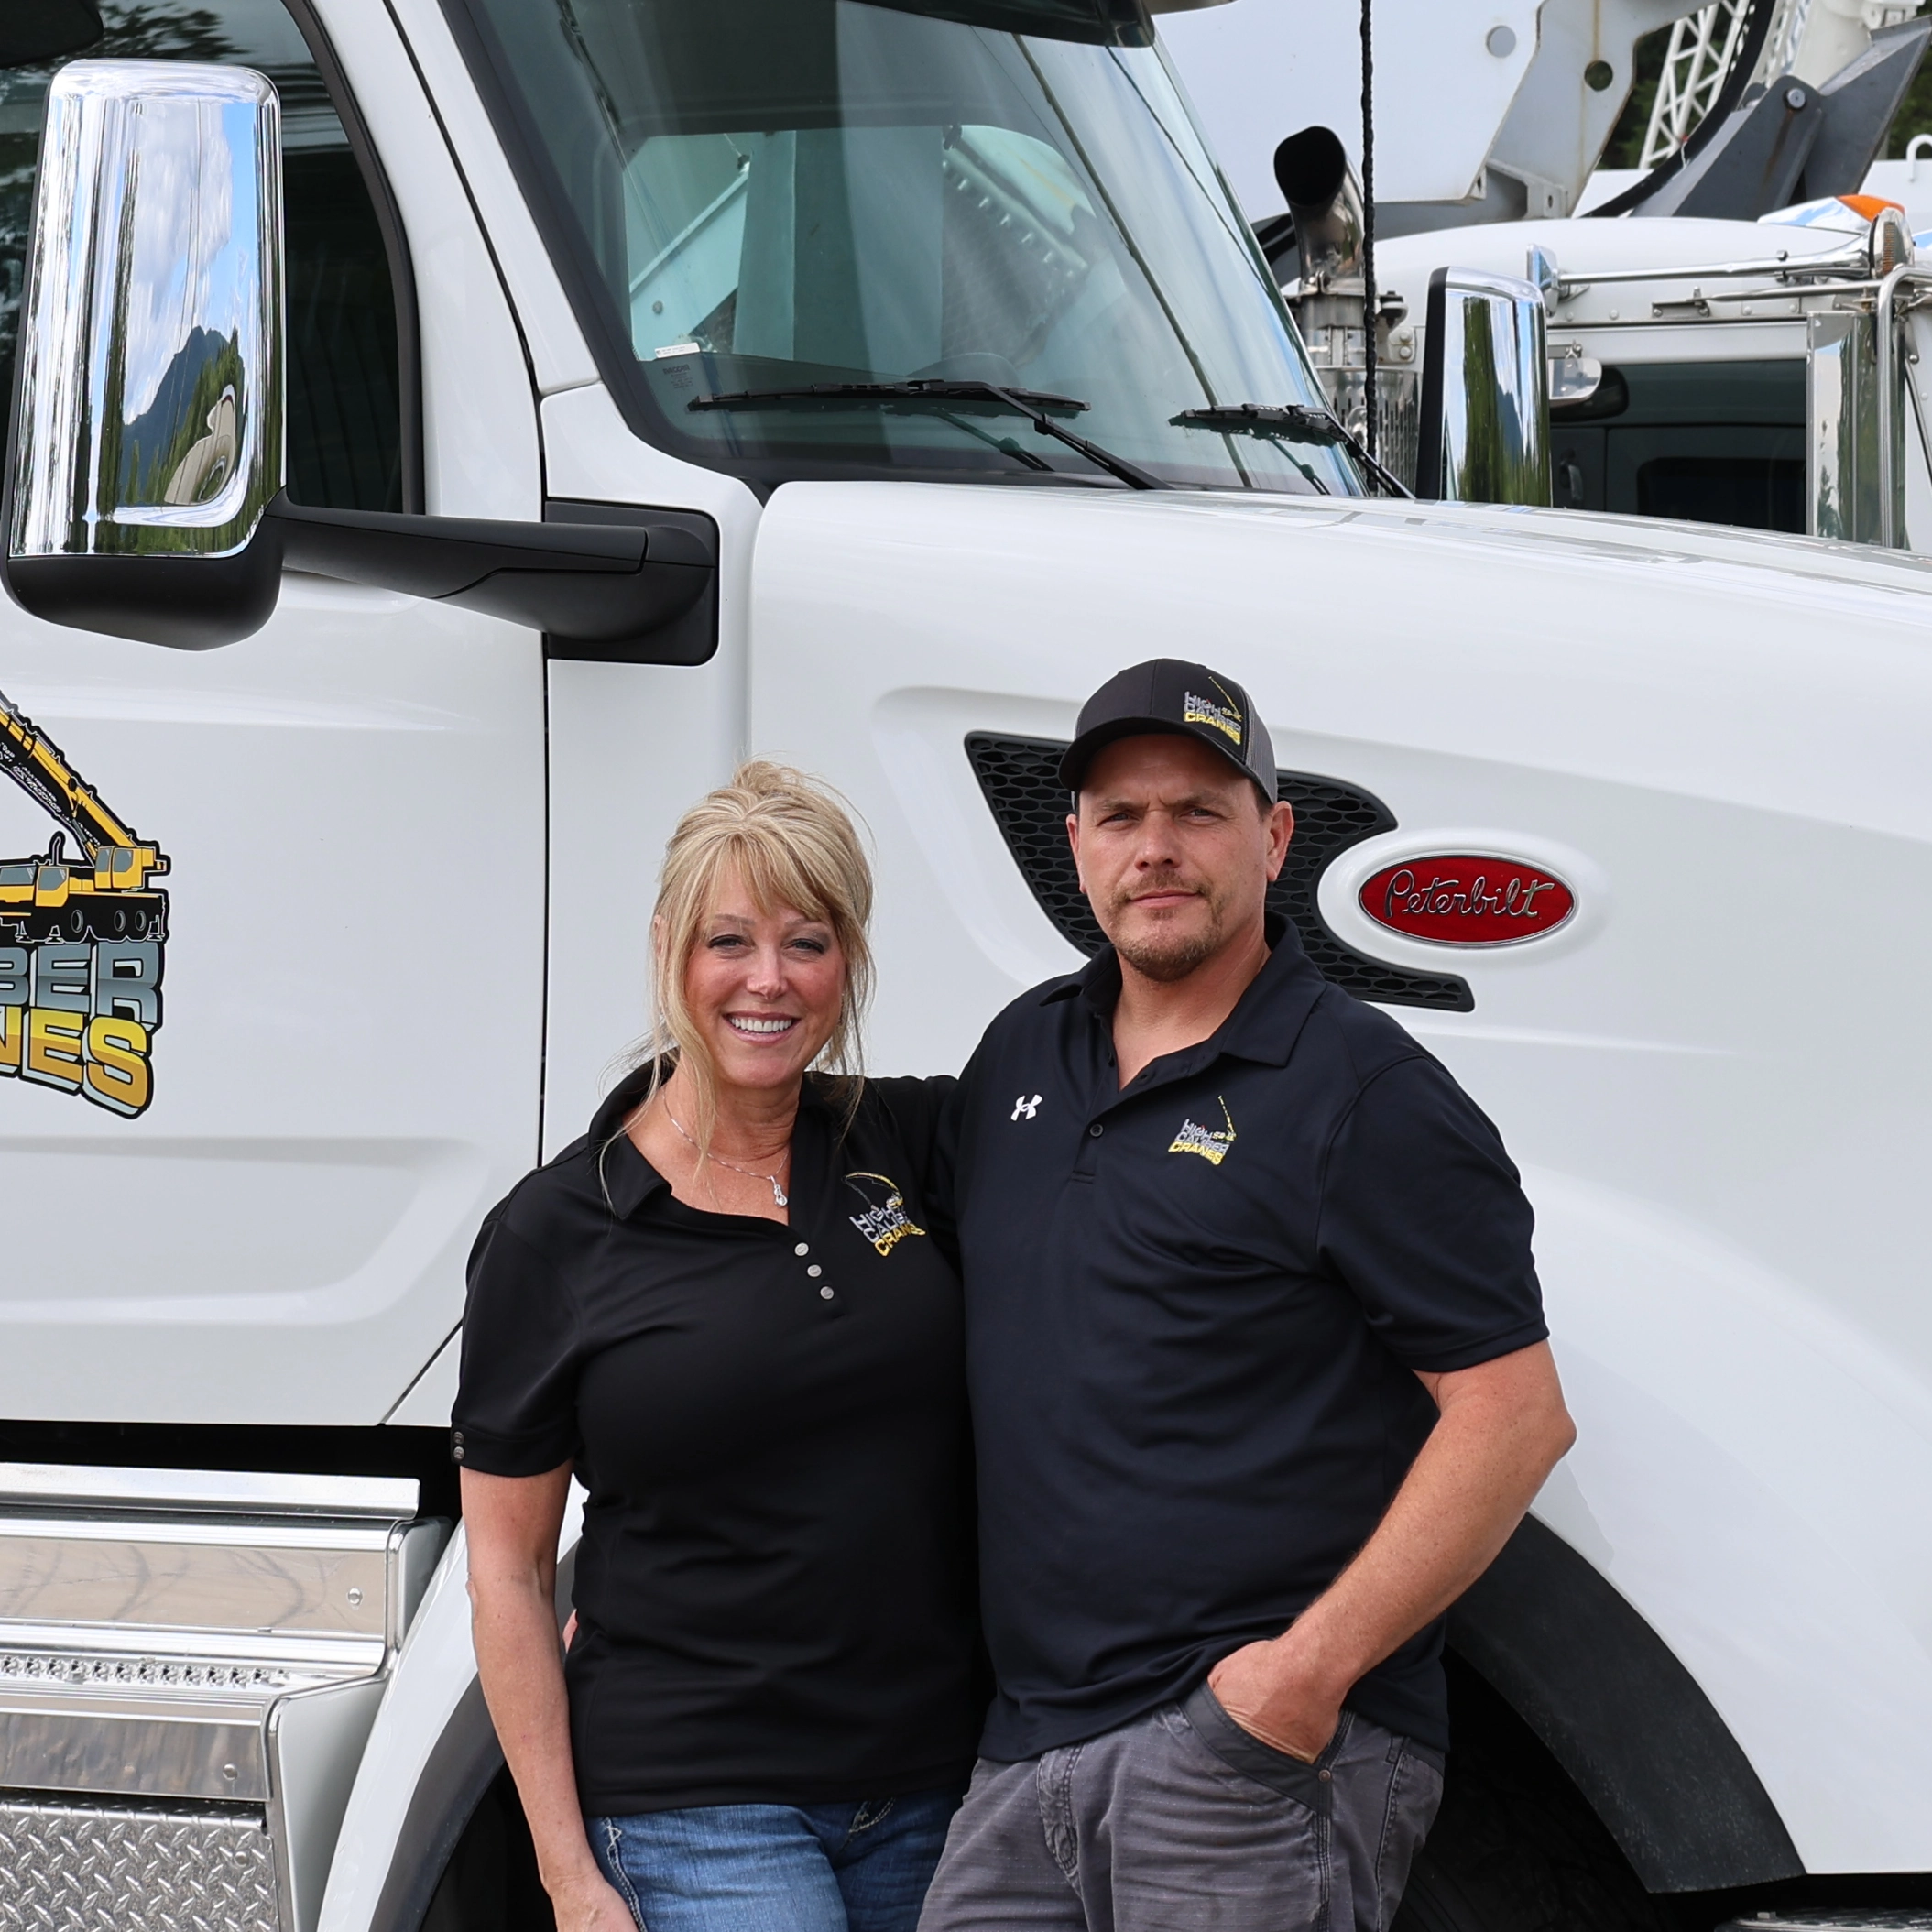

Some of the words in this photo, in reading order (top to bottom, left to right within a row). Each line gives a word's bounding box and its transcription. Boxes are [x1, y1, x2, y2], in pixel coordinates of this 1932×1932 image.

[1384, 869, 1555, 919] Peterbilt
[1181, 1118, 1214, 1140] HIGH
[1168, 1141, 1224, 1165] CRANES
[1174, 1131, 1230, 1156] CALIBER
[849, 1204, 897, 1231] HIGH
